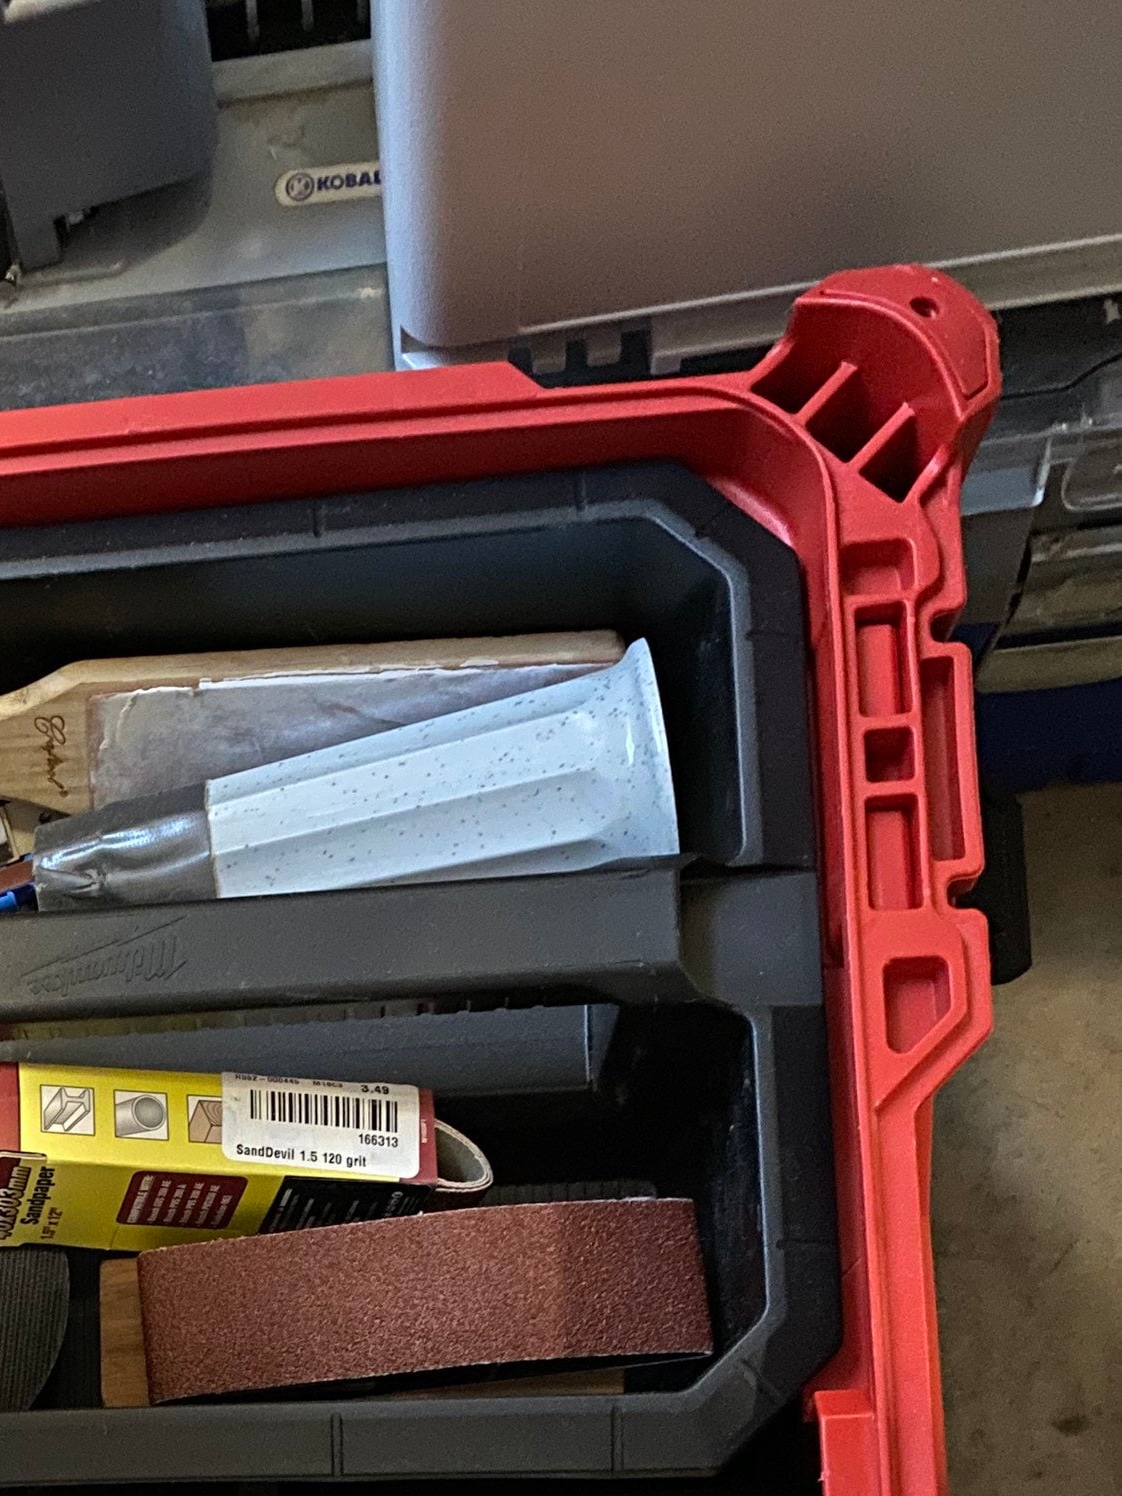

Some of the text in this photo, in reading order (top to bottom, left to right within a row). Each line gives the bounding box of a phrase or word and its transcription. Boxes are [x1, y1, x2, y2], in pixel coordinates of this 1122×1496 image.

[361, 1084, 390, 1095] 3.49
[358, 1133, 399, 1148] 166313
[236, 1144, 367, 1168] SandDevil 1.5 120 grit
[20, 1166, 56, 1226] Sandpaper
